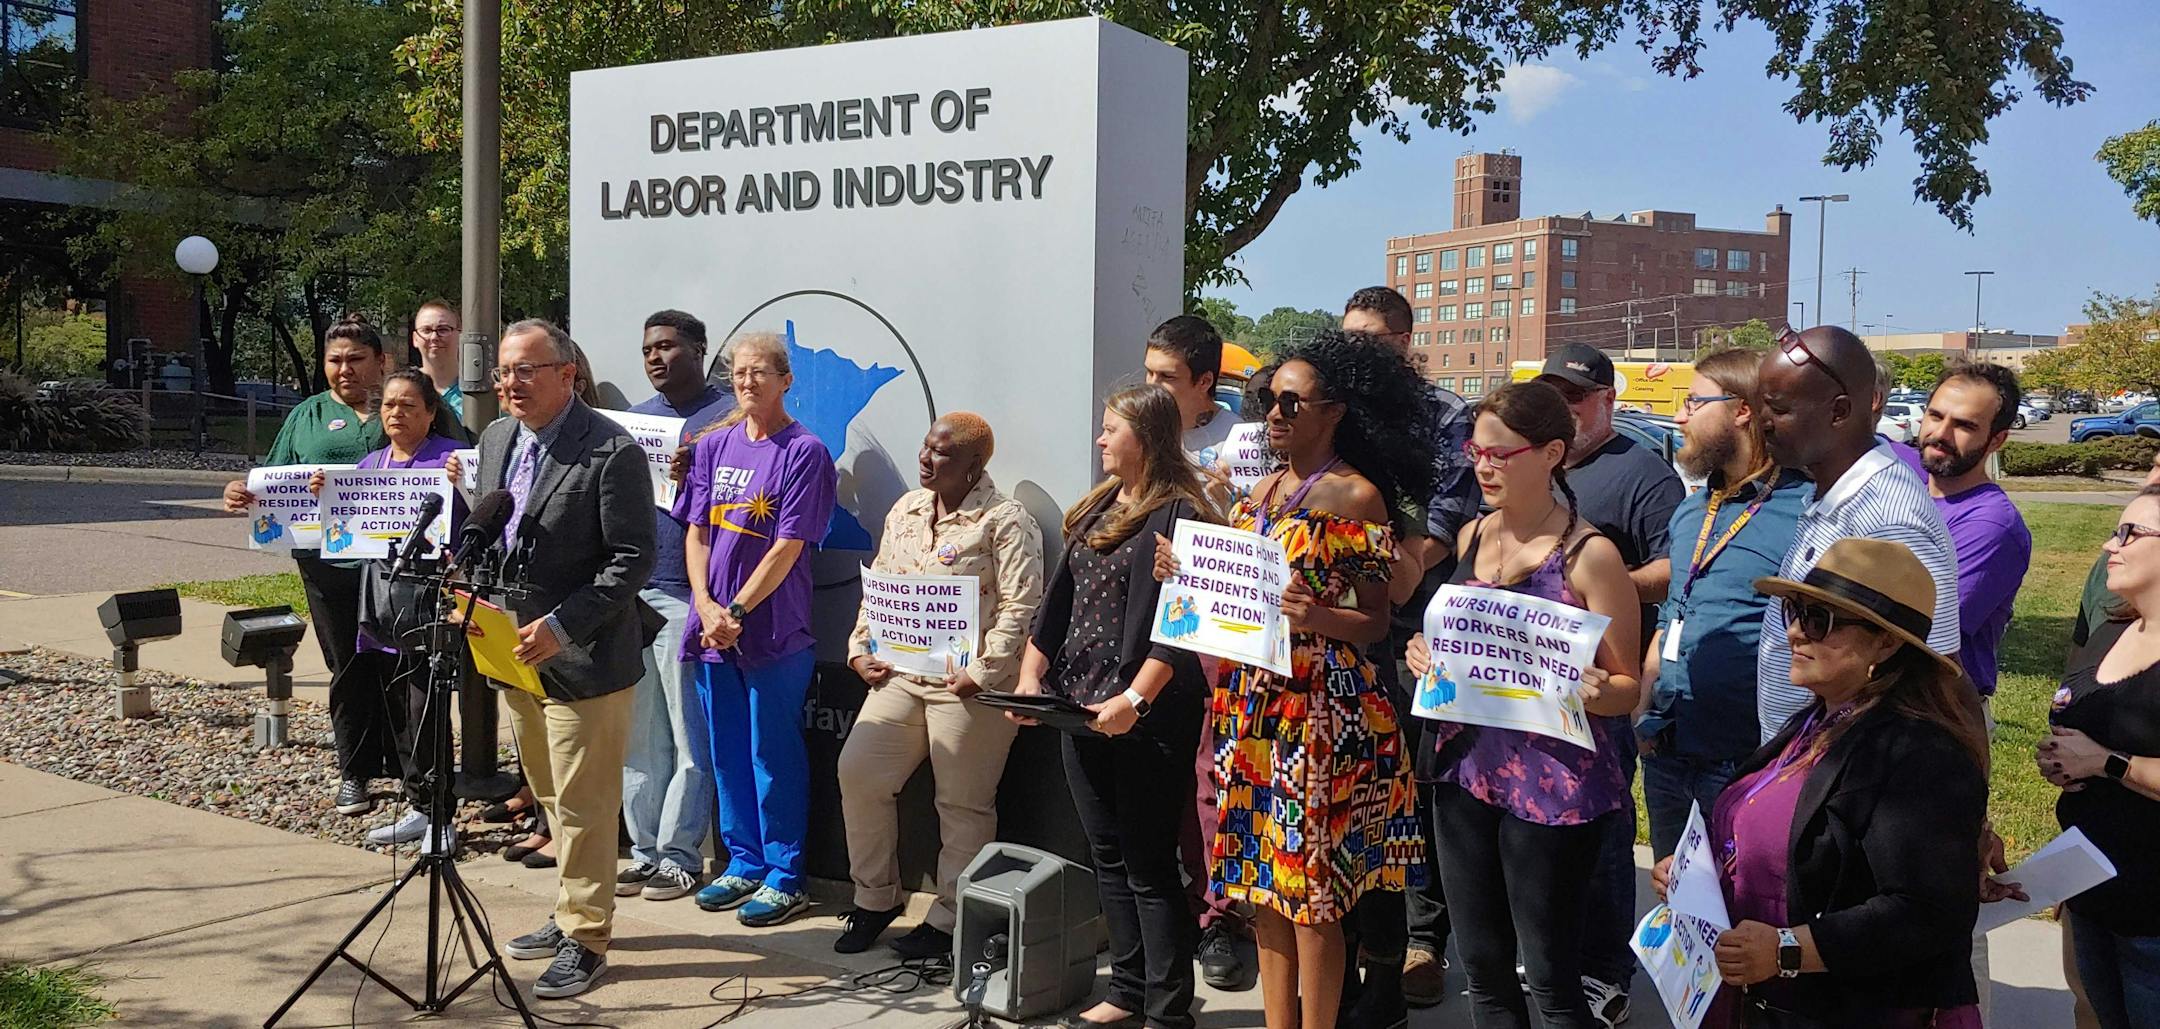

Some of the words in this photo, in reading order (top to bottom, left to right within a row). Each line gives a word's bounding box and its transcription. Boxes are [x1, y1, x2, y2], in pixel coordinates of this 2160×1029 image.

[650, 93, 919, 154] DEPARTMENT
[930, 87, 992, 132] OF
[601, 174, 727, 220] LABOR
[735, 169, 821, 214] AND
[832, 154, 1054, 209] INDUSTRY
[637, 436, 663, 448] AND
[334, 477, 397, 487] NURSING
[402, 476, 441, 486] HOME
[338, 491, 406, 501] WORKERS
[330, 506, 406, 516] RESIDENTS
[1192, 533, 1253, 557] NURSING
[1256, 546, 1280, 566] HOME
[1192, 555, 1260, 580] WORKERS
[1262, 569, 1280, 587] AND
[916, 584, 962, 596] HOME
[1178, 574, 1259, 601] RESIDENTS
[866, 608, 921, 629] ESIDENTS
[926, 619, 968, 630] NEED
[925, 601, 958, 613] AND
[1210, 600, 1266, 625] ACTION!
[1445, 595, 1520, 620] NURSING
[1524, 608, 1584, 635] HOME
[881, 629, 932, 647] ACTION!
[1443, 615, 1529, 644] WORKERS
[1535, 635, 1571, 654] AND
[1432, 637, 1534, 665] RESIDENTS
[1539, 654, 1581, 682] NEED
[1468, 665, 1546, 692] ACTION!
